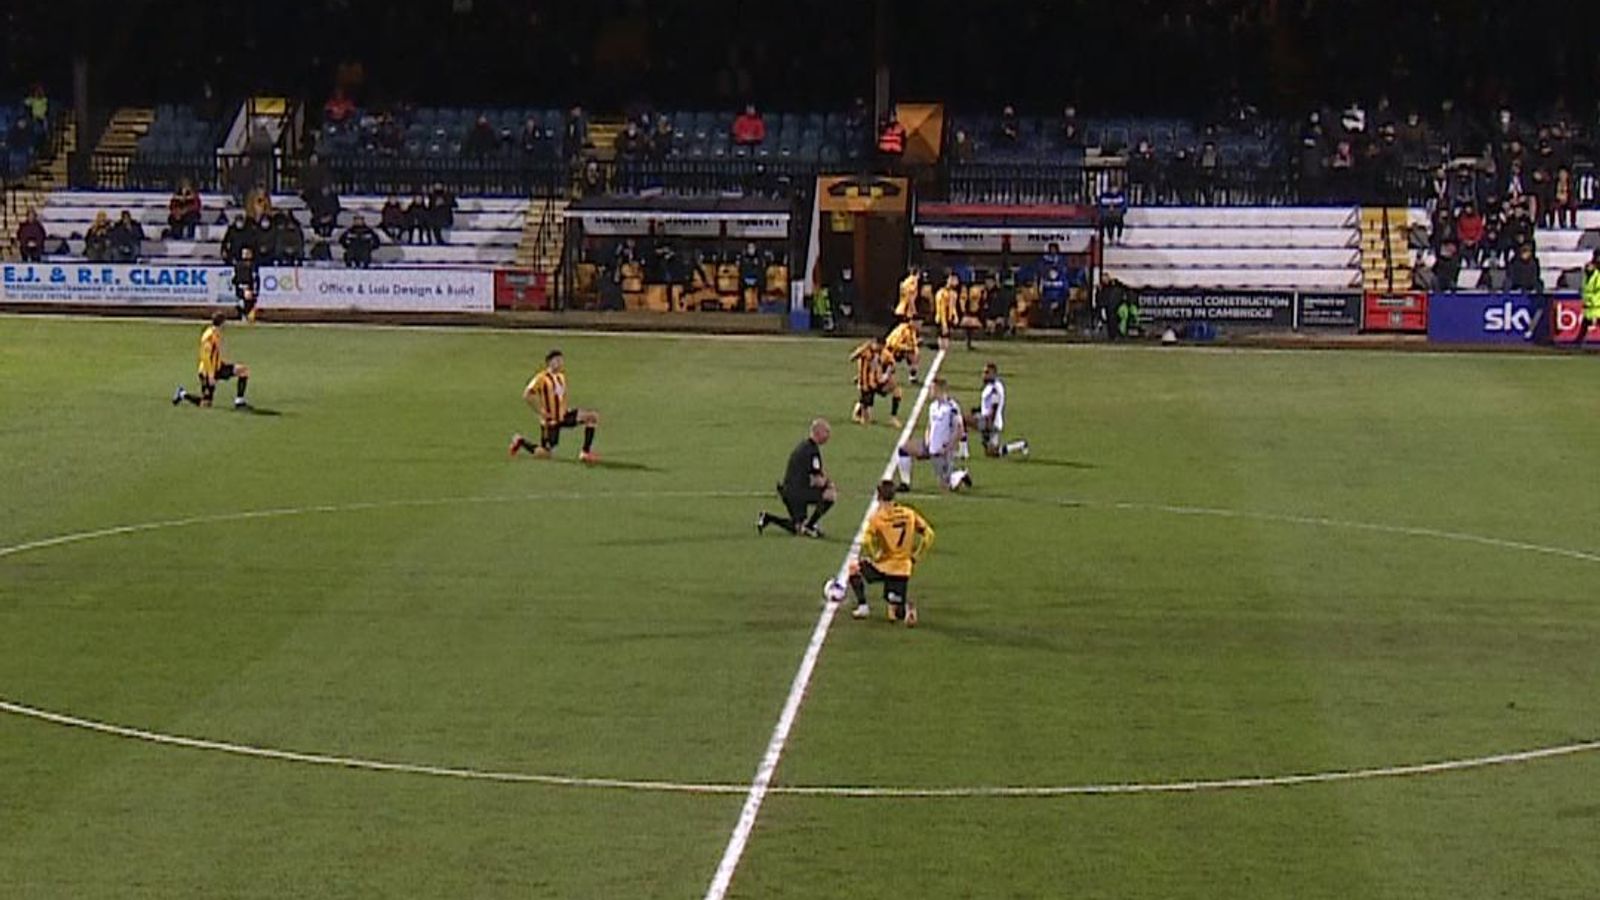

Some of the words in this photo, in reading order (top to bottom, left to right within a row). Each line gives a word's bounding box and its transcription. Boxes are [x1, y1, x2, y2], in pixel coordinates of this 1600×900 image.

[3, 266, 41, 283] E.J.
[50, 266, 66, 283] &
[77, 268, 121, 285] R.E.
[129, 268, 208, 286] CLARK
[318, 281, 354, 295] Office
[357, 283, 365, 295] &
[392, 284, 433, 297] Design
[447, 284, 475, 296] Build
[1138, 296, 1203, 306] DELIVERING
[1204, 296, 1289, 307] CONSTRUCTION
[1194, 307, 1206, 318] IN
[1208, 308, 1273, 318] CAMBRIDGE
[1484, 302, 1543, 338] sky
[892, 521, 906, 547] 7
